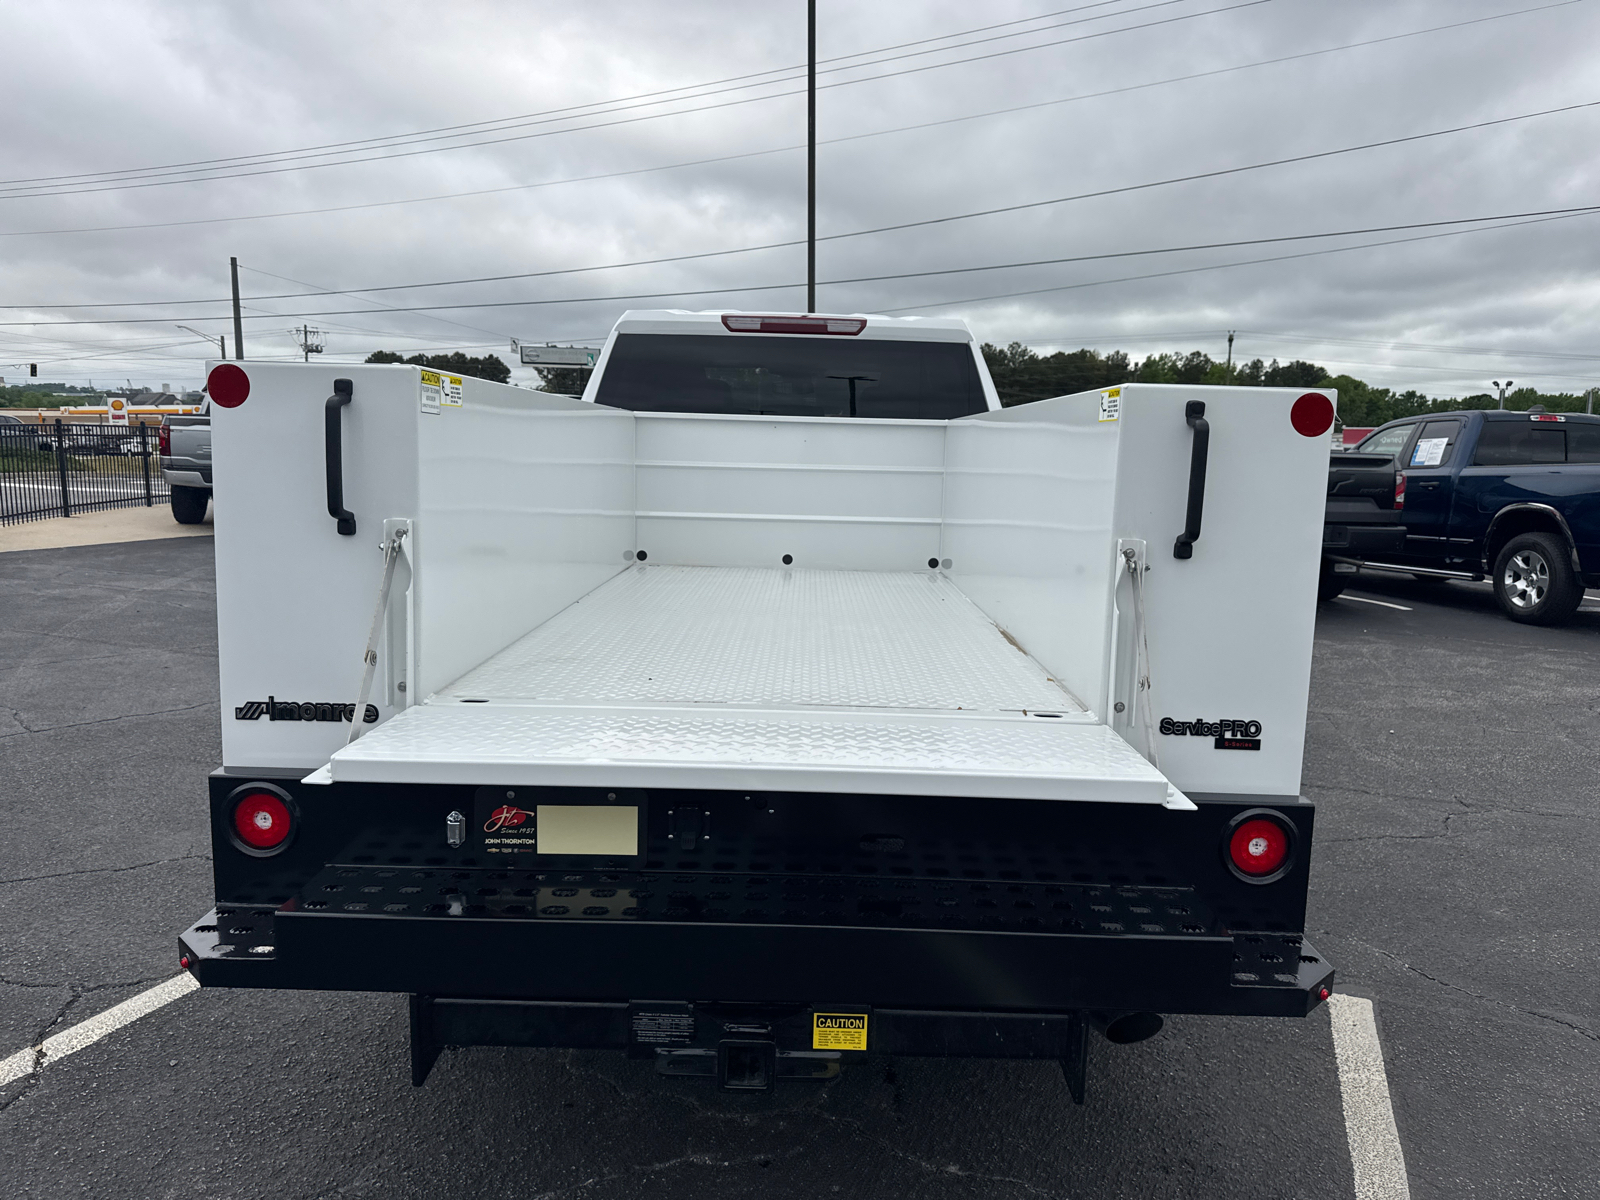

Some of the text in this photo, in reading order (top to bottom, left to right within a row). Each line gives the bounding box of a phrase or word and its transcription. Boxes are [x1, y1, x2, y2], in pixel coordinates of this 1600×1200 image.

[273, 701, 379, 723] monroe
[1159, 717, 1262, 738] ServicePRO
[817, 1017, 864, 1030] CAUTION
